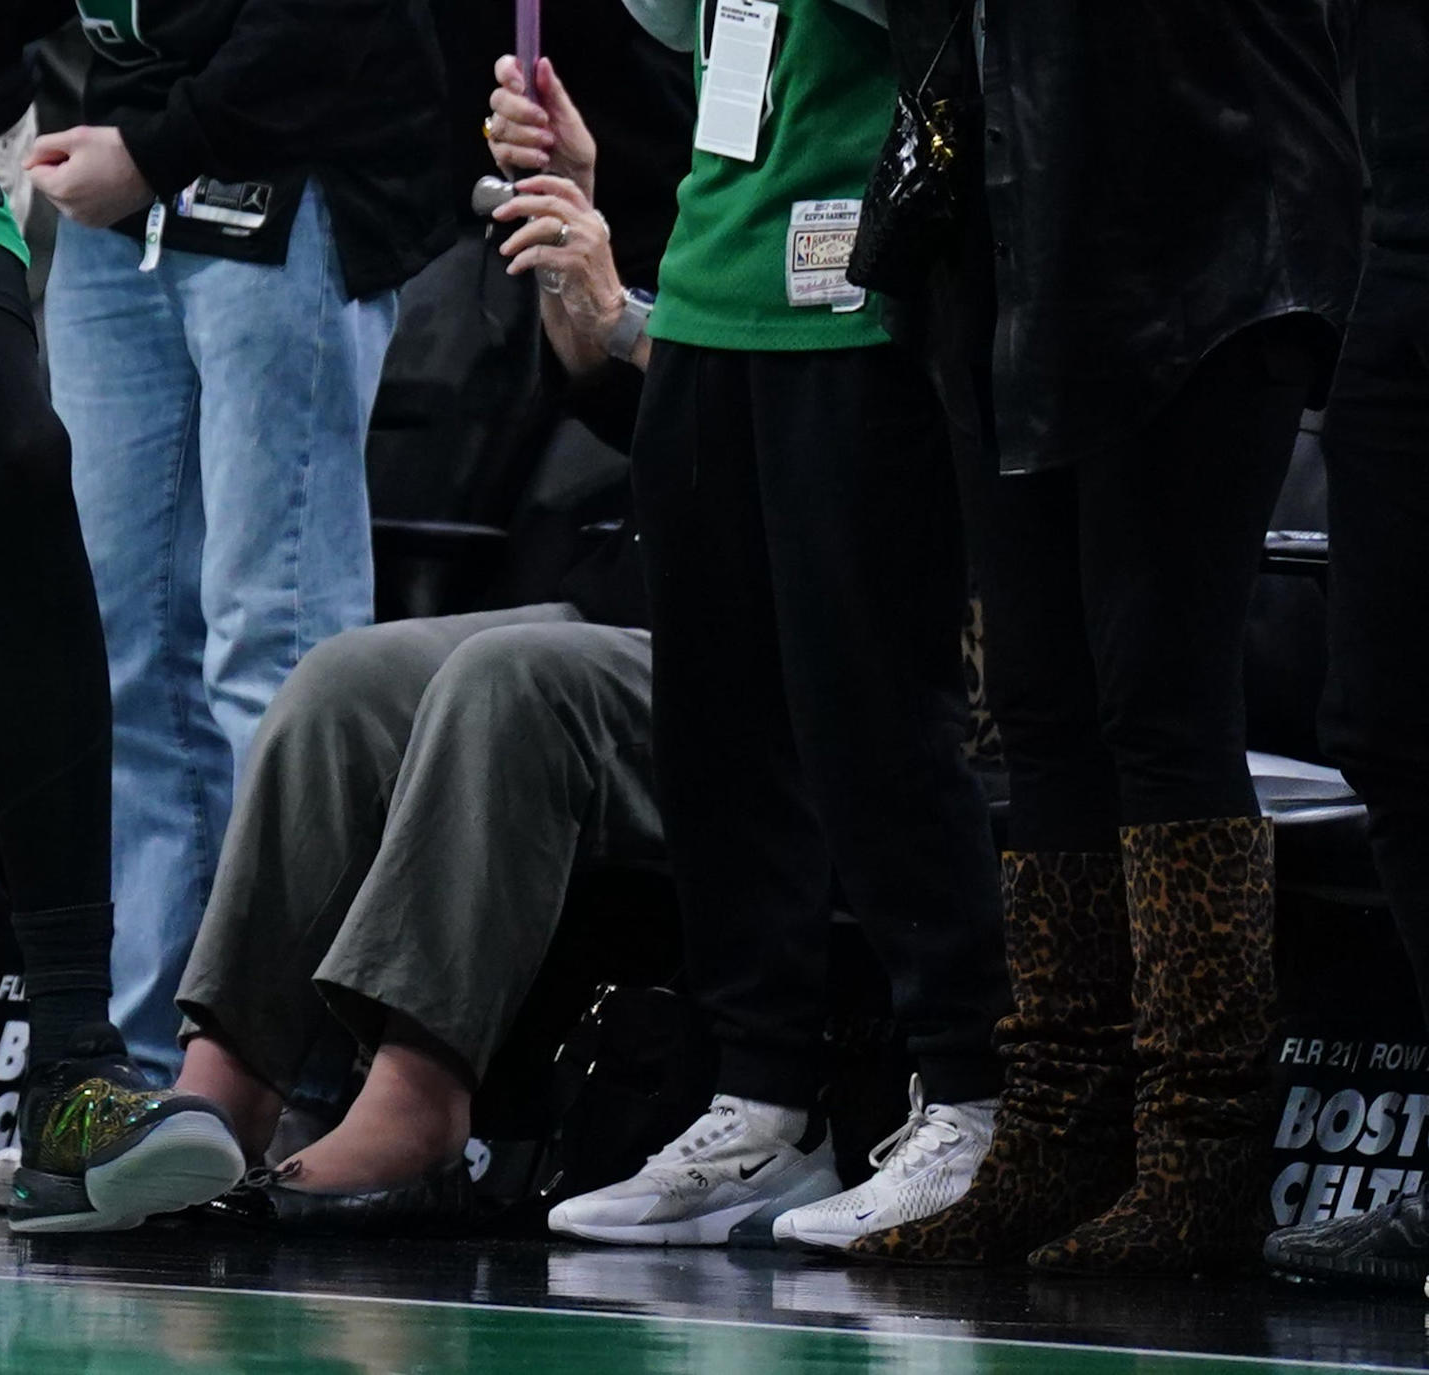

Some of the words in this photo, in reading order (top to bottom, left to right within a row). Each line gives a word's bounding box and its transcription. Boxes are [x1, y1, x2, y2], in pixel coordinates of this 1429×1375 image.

[1278, 1037, 1325, 1066] FLR
[1368, 1043, 1427, 1072] ROW
[1272, 1086, 1429, 1158] BOST
